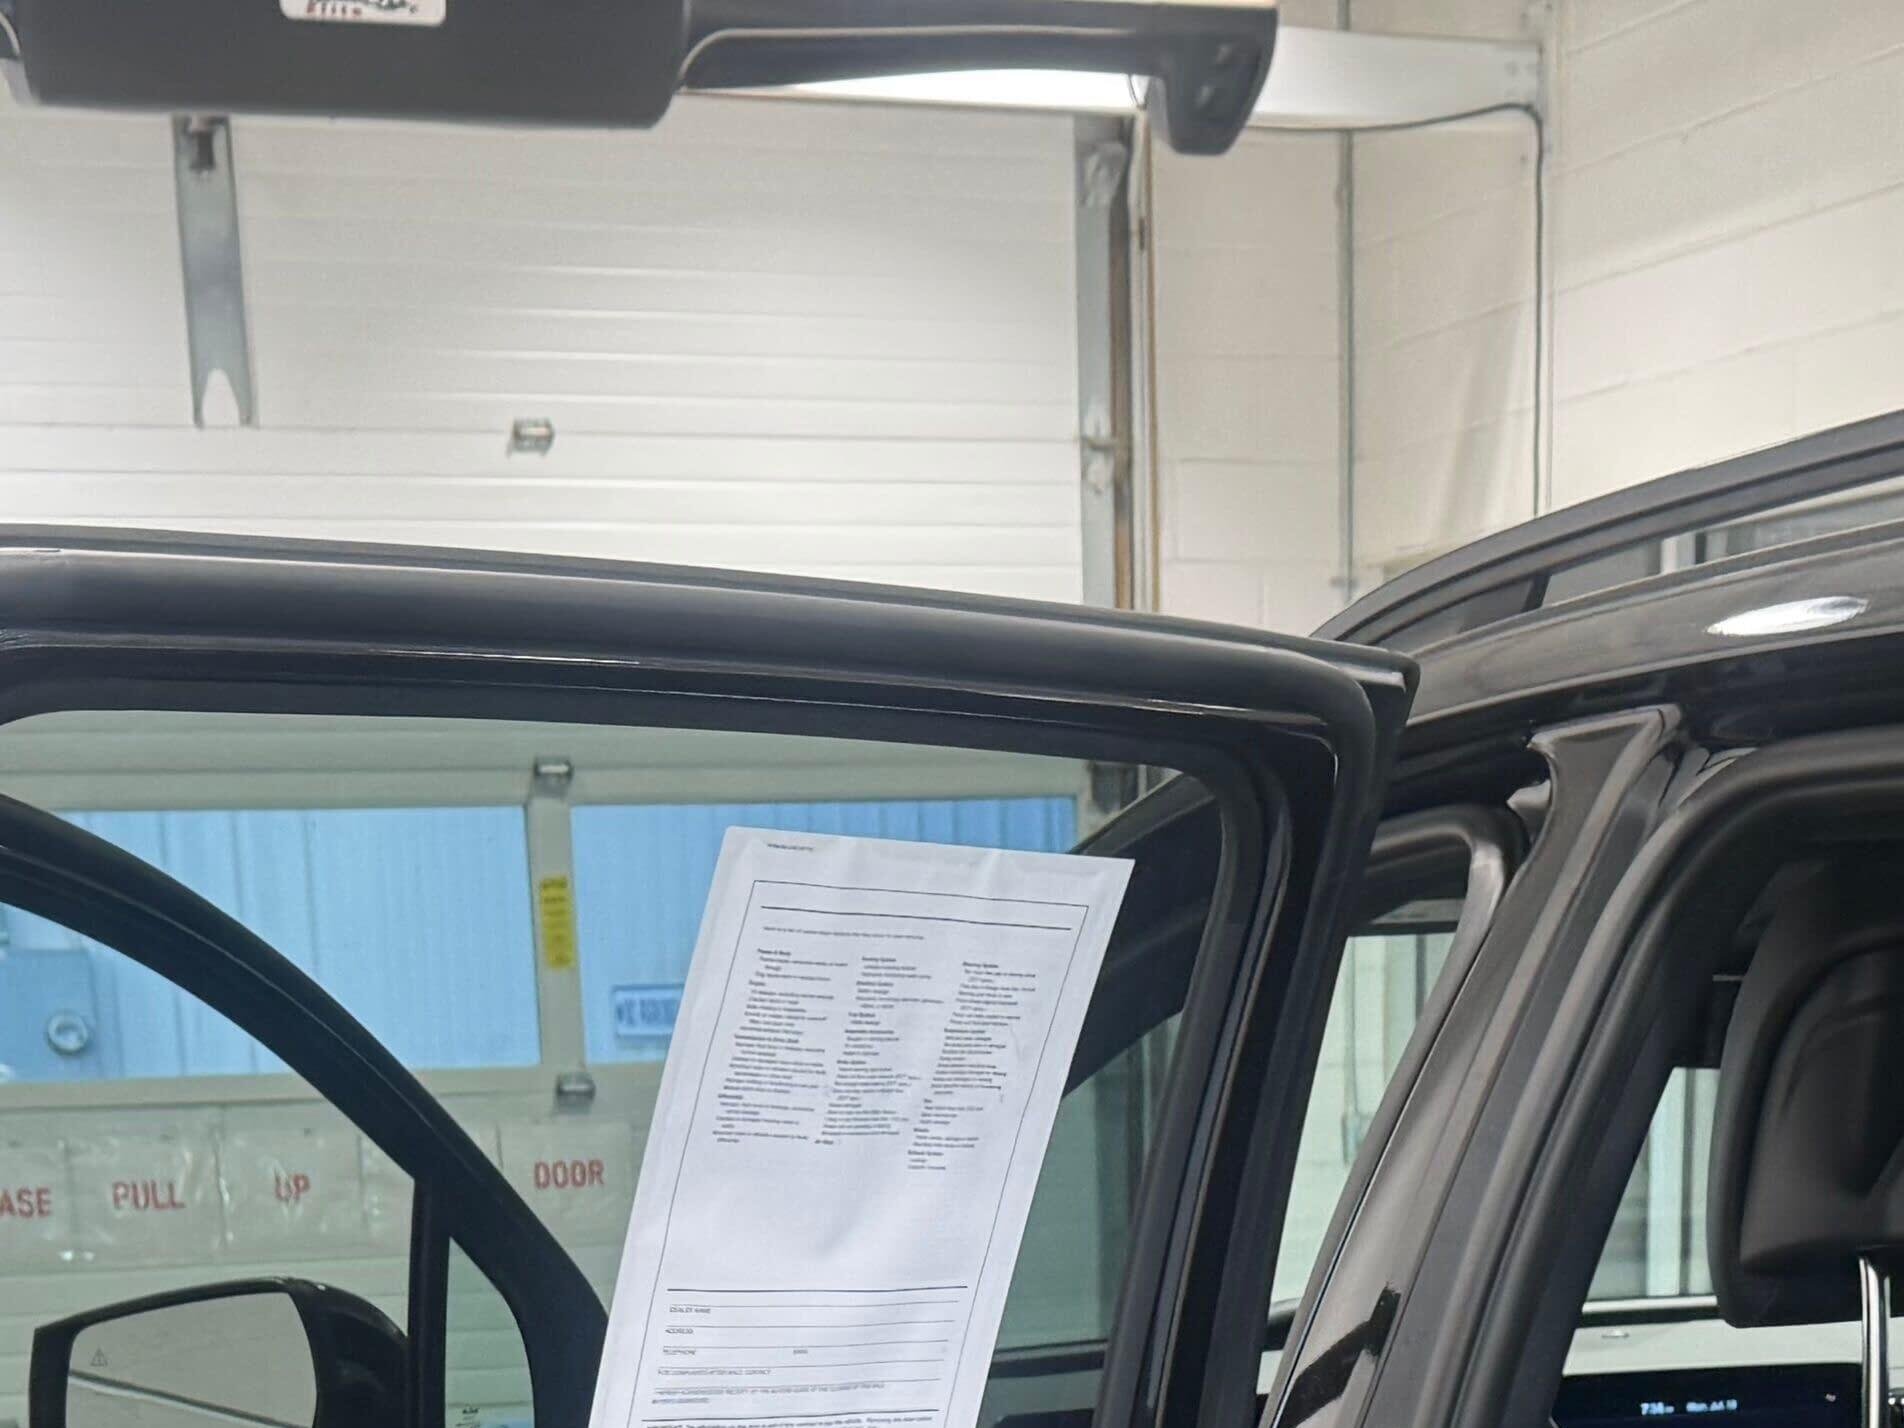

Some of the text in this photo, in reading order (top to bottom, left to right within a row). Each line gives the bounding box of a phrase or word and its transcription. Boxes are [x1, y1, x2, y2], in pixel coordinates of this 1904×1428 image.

[111, 1179, 185, 1210] PULL
[273, 1170, 311, 1202] UP
[533, 1159, 605, 1190] DOOR
